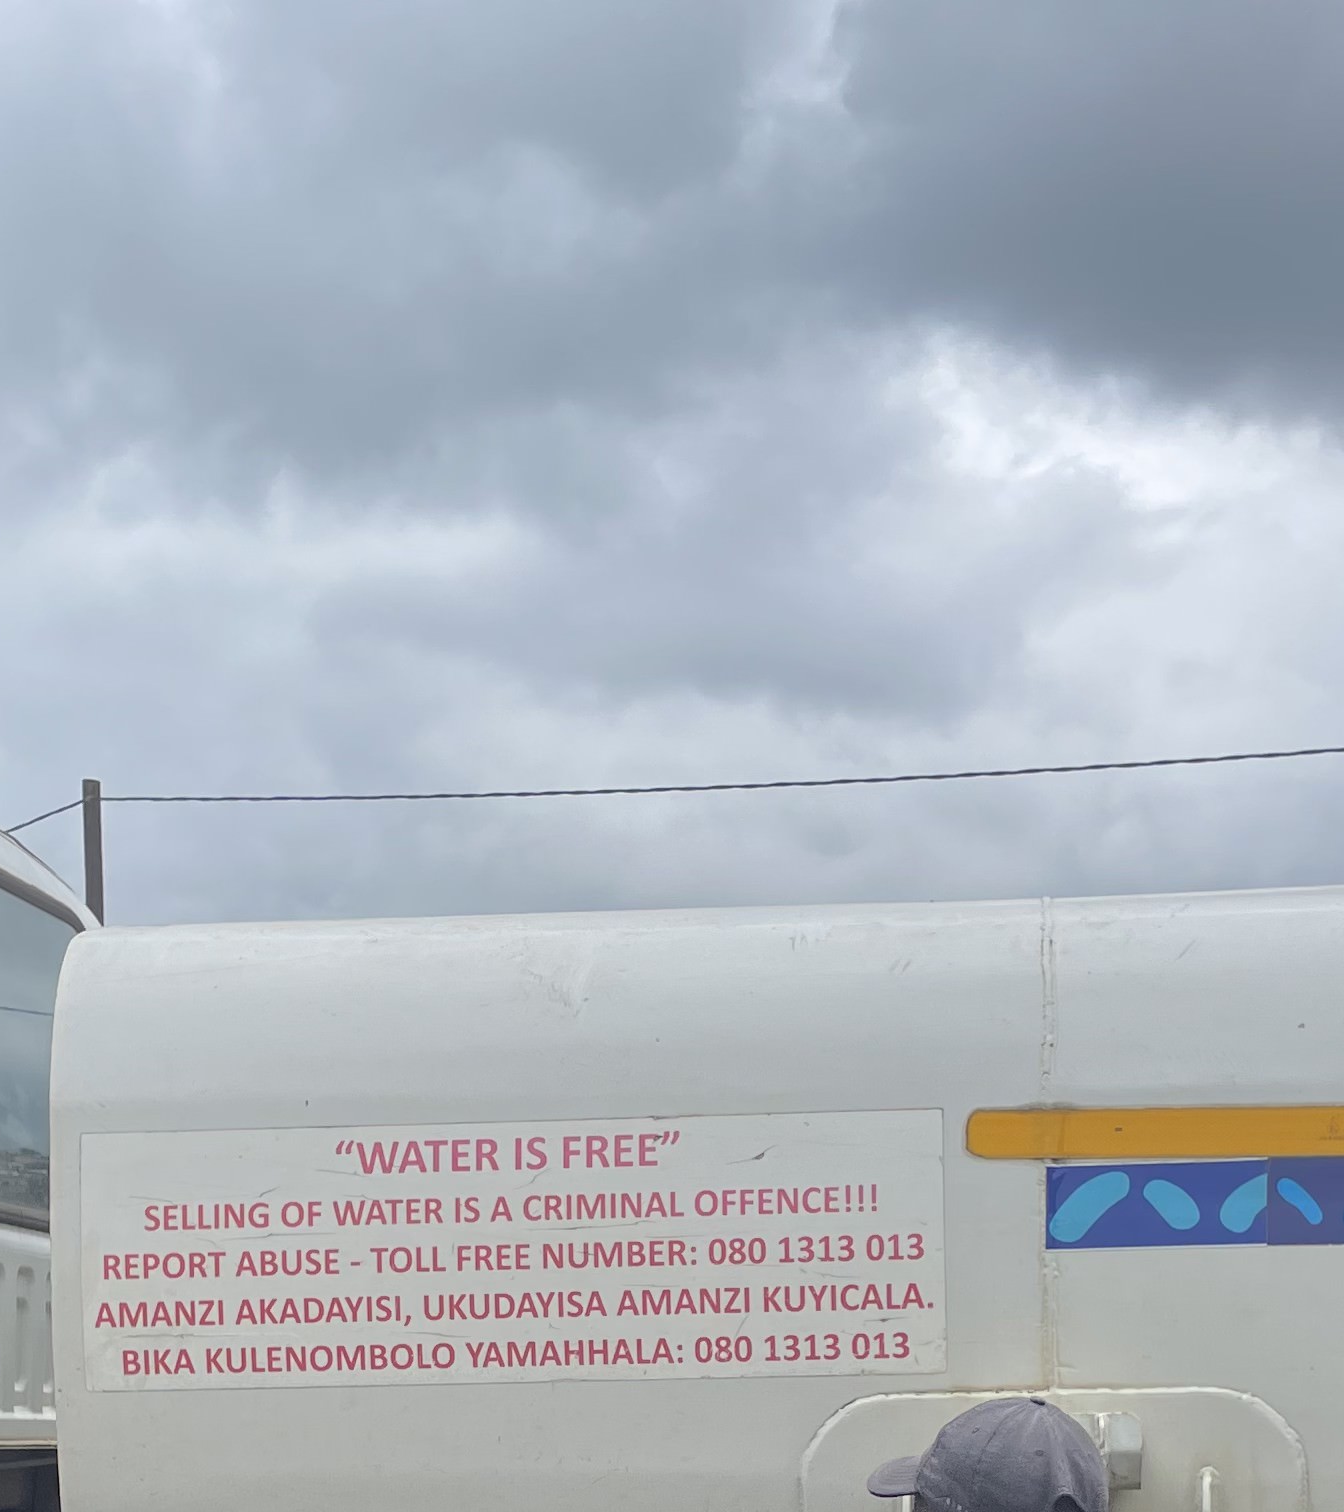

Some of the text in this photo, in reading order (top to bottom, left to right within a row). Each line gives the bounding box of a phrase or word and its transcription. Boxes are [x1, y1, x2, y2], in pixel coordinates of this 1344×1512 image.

[513, 1136, 549, 1172] IS
[143, 1182, 879, 1233] SELLING OF WATER IS A CRIMINAL OFFENCE!!!
[101, 1250, 226, 1281] REPORT
[235, 1247, 339, 1278] ABUSE
[370, 1246, 447, 1275] TOLL
[455, 1242, 530, 1273] FREE
[541, 1238, 697, 1270] NUMBER:
[707, 1236, 768, 1266] 080
[778, 1233, 856, 1265] 1313
[865, 1232, 925, 1263] 013
[94, 1281, 936, 1331] AMANZI AKADAYISI, UKUDAYISA AMANZI KUYICALA.
[121, 1330, 911, 1377] BIKA KULENOMBOLO YAMAHHALA: 080 1313 013
